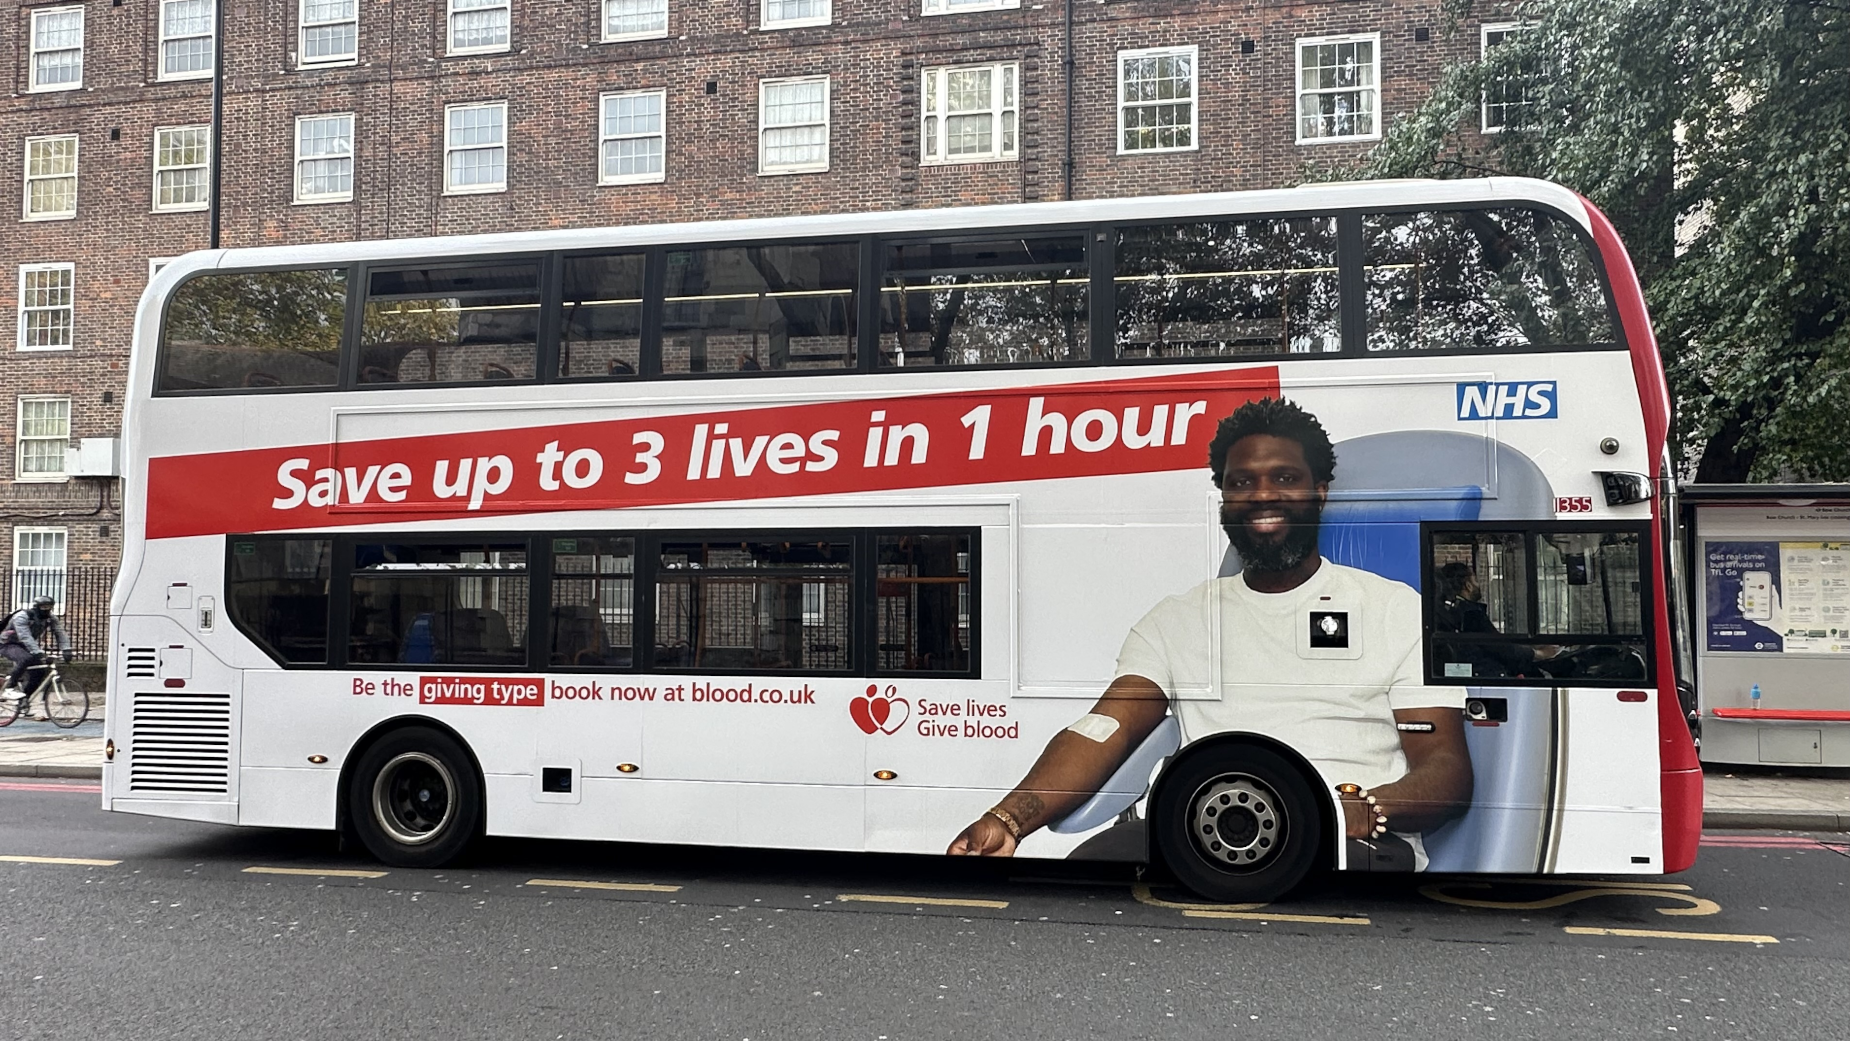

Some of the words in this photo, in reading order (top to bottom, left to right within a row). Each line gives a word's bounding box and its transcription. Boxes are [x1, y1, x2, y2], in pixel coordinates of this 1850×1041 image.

[1459, 383, 1554, 418] NHS
[272, 458, 412, 510] Save
[432, 454, 514, 510] up
[536, 440, 604, 491] to
[624, 430, 665, 485] 3
[686, 422, 840, 481] lives
[863, 410, 930, 468] in
[960, 404, 992, 460] 1
[1021, 396, 1207, 457] hour
[1709, 553, 1725, 561] Get
[1710, 561, 1724, 569] bus
[1725, 561, 1753, 569] arrivals
[1725, 568, 1738, 576] Go
[353, 678, 375, 696] Be
[382, 678, 414, 697] the
[423, 679, 484, 704] giving
[491, 682, 538, 705] type
[551, 681, 602, 700] book
[611, 686, 657, 702] now
[663, 685, 685, 702] at
[692, 682, 816, 705] blood.co.uk
[918, 699, 961, 716] Save
[966, 699, 1007, 717] lives
[917, 720, 958, 737] Give
[964, 720, 1019, 739] blood
